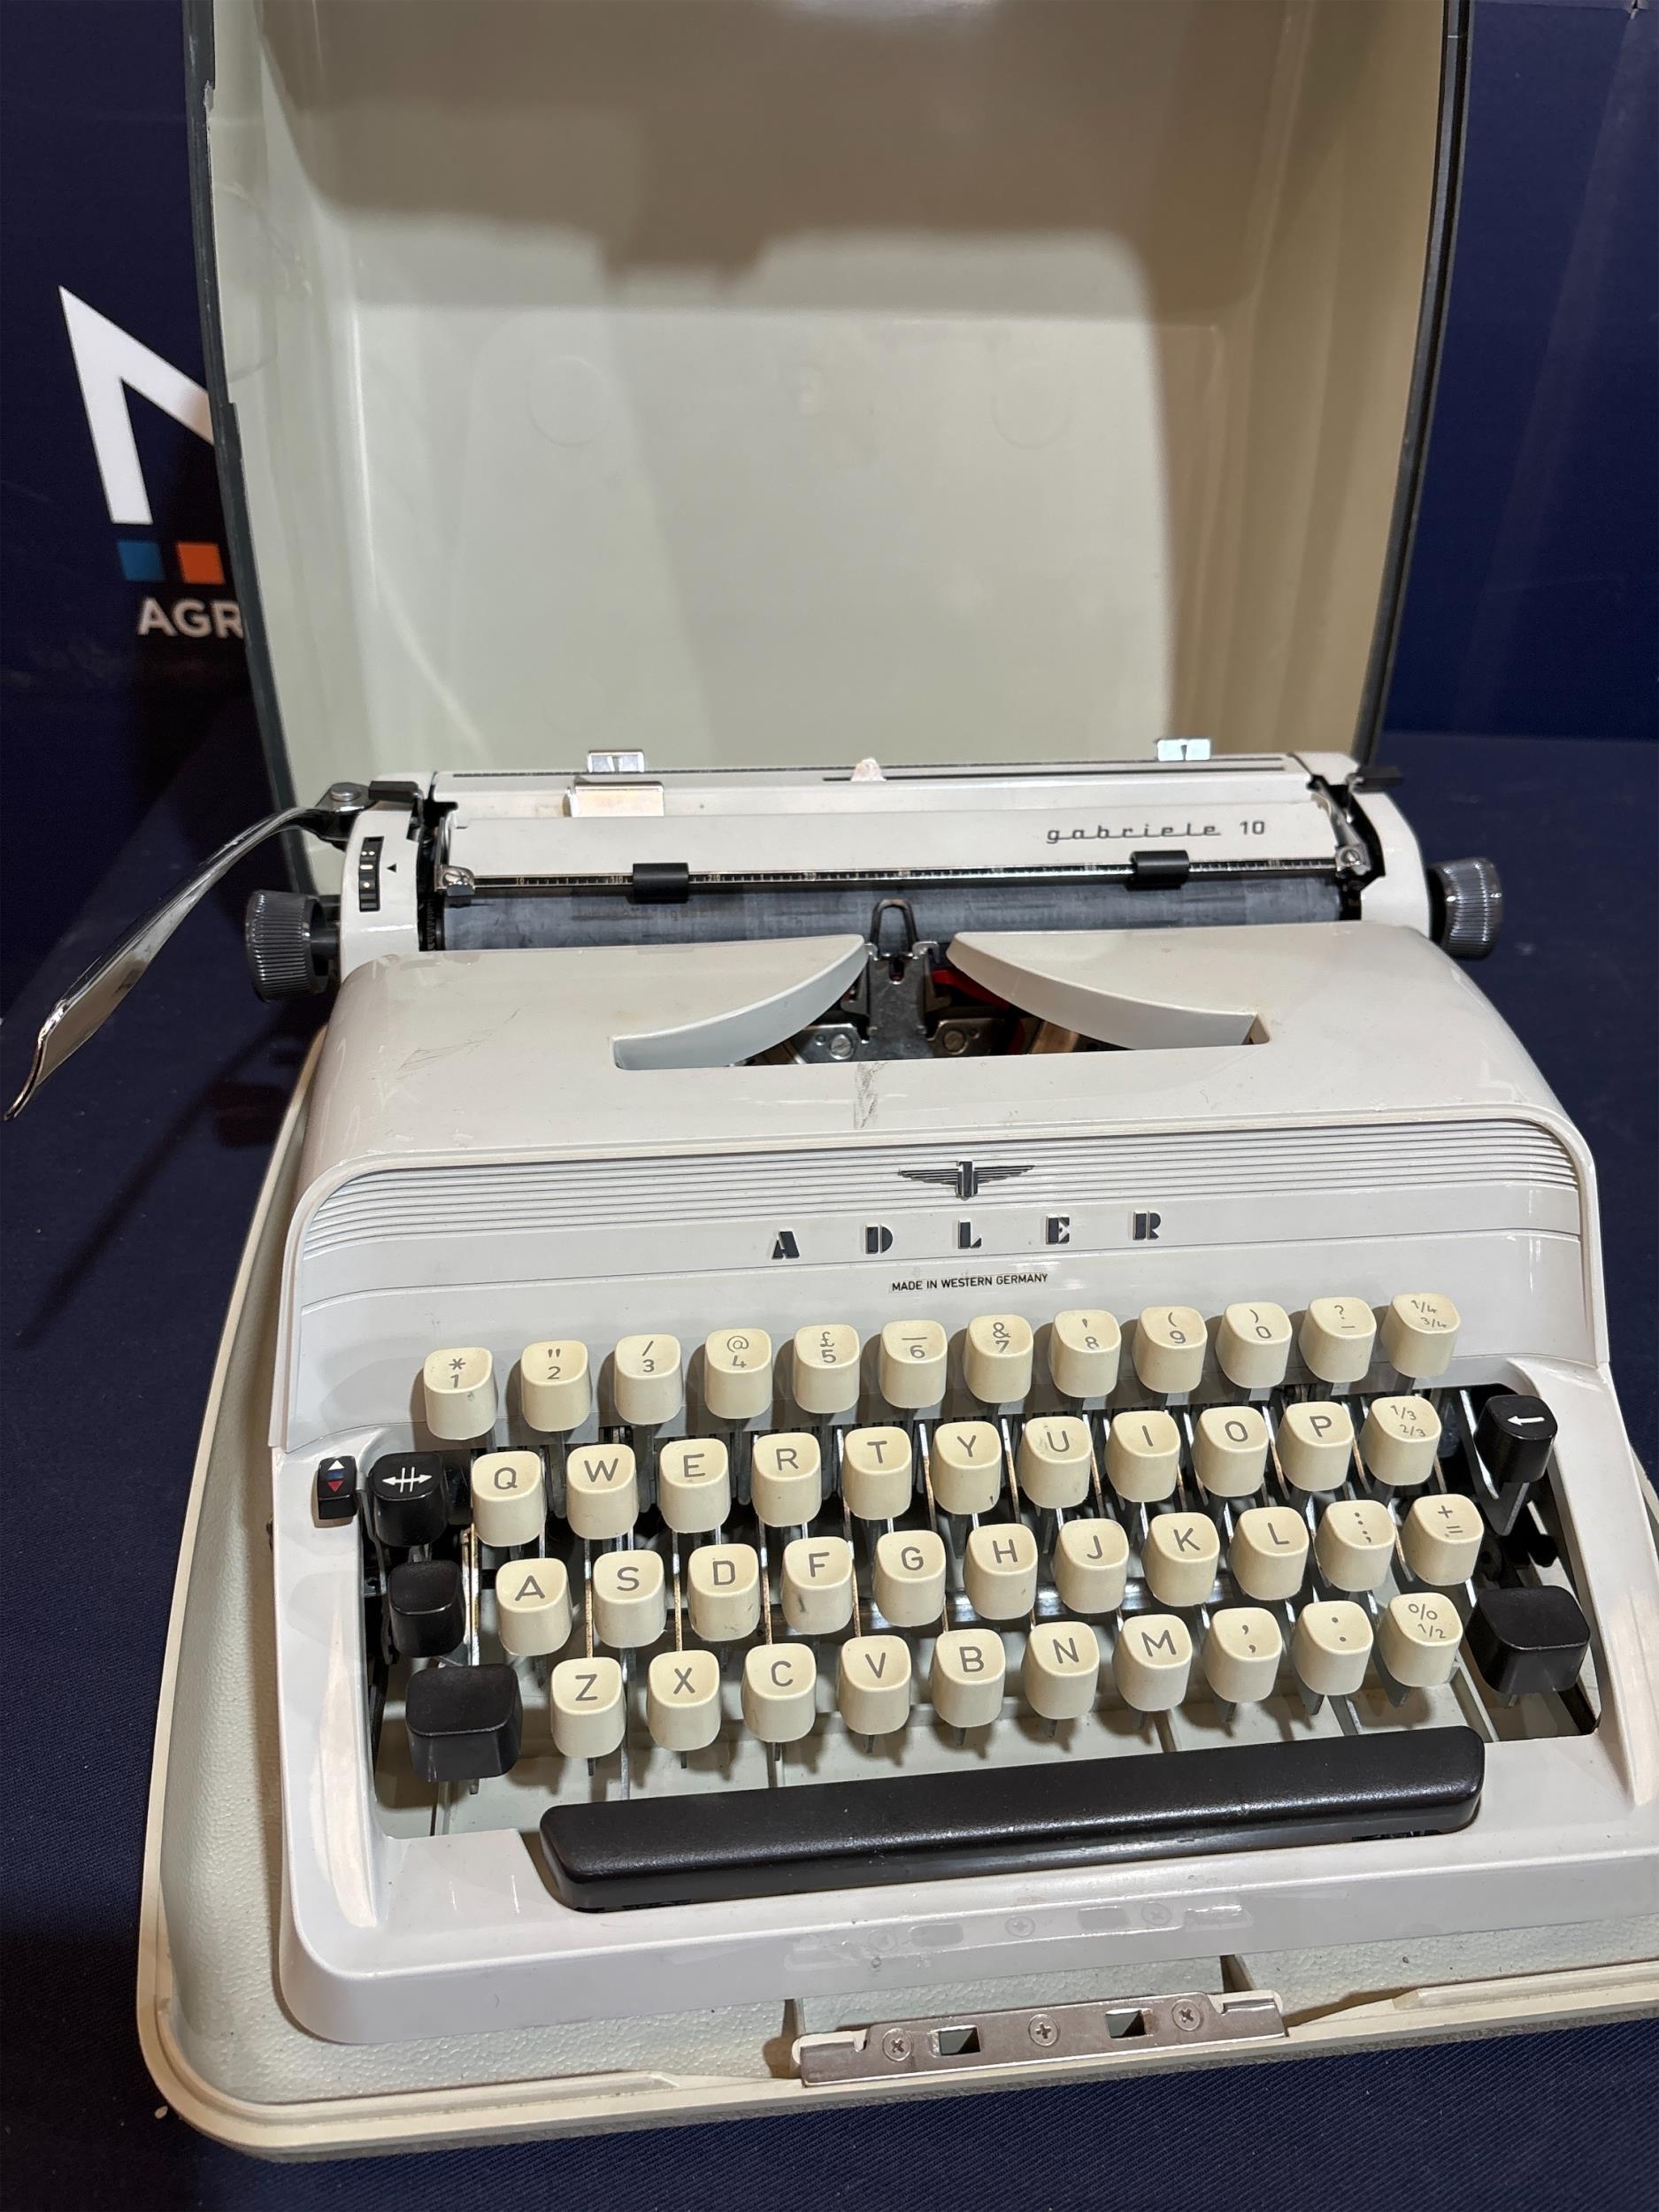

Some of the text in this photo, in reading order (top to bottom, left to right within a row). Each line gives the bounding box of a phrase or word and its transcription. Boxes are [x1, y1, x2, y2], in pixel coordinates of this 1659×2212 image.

[1047, 821, 1264, 845] gabriele 10
[772, 1211, 1161, 1258] ADLER
[892, 1273, 1048, 1292] MADE IN WESTERN GERMANY
[1333, 1304, 1346, 1320] ?
[819, 1331, 835, 1348] £
[992, 1322, 1012, 1340] &
[1084, 1336, 1100, 1350] 8
[1169, 1330, 1187, 1344] 9
[1256, 1325, 1272, 1340] 0
[726, 1335, 749, 1353] @
[821, 1348, 837, 1363] 5
[909, 1344, 926, 1359] 6
[995, 1340, 1010, 1354] 7
[547, 1365, 561, 1380] 2
[642, 1358, 655, 1373] 3
[732, 1355, 748, 1369] 4
[449, 1373, 459, 1389] 1
[1141, 1425, 1154, 1448] I
[1224, 1420, 1249, 1443] O
[1309, 1415, 1333, 1438] P
[866, 1440, 888, 1464] T
[956, 1434, 977, 1458] Y
[1046, 1430, 1071, 1453] U
[583, 1457, 619, 1483] W
[683, 1453, 706, 1479] E
[775, 1448, 800, 1471] R
[494, 1466, 518, 1491] Q
[1173, 1527, 1202, 1553] K
[1267, 1522, 1291, 1546] L
[901, 1546, 925, 1571] G
[992, 1538, 1018, 1564] H
[1086, 1534, 1103, 1560] J
[712, 1559, 736, 1586] D
[808, 1551, 831, 1578] F
[514, 1575, 546, 1601] A
[616, 1566, 640, 1592] S
[1052, 1637, 1080, 1664] N
[1141, 1629, 1178, 1658] M
[864, 1652, 887, 1679] V
[958, 1646, 985, 1673] B
[672, 1667, 696, 1695] X
[771, 1660, 794, 1687] C
[574, 1673, 598, 1701] Z
